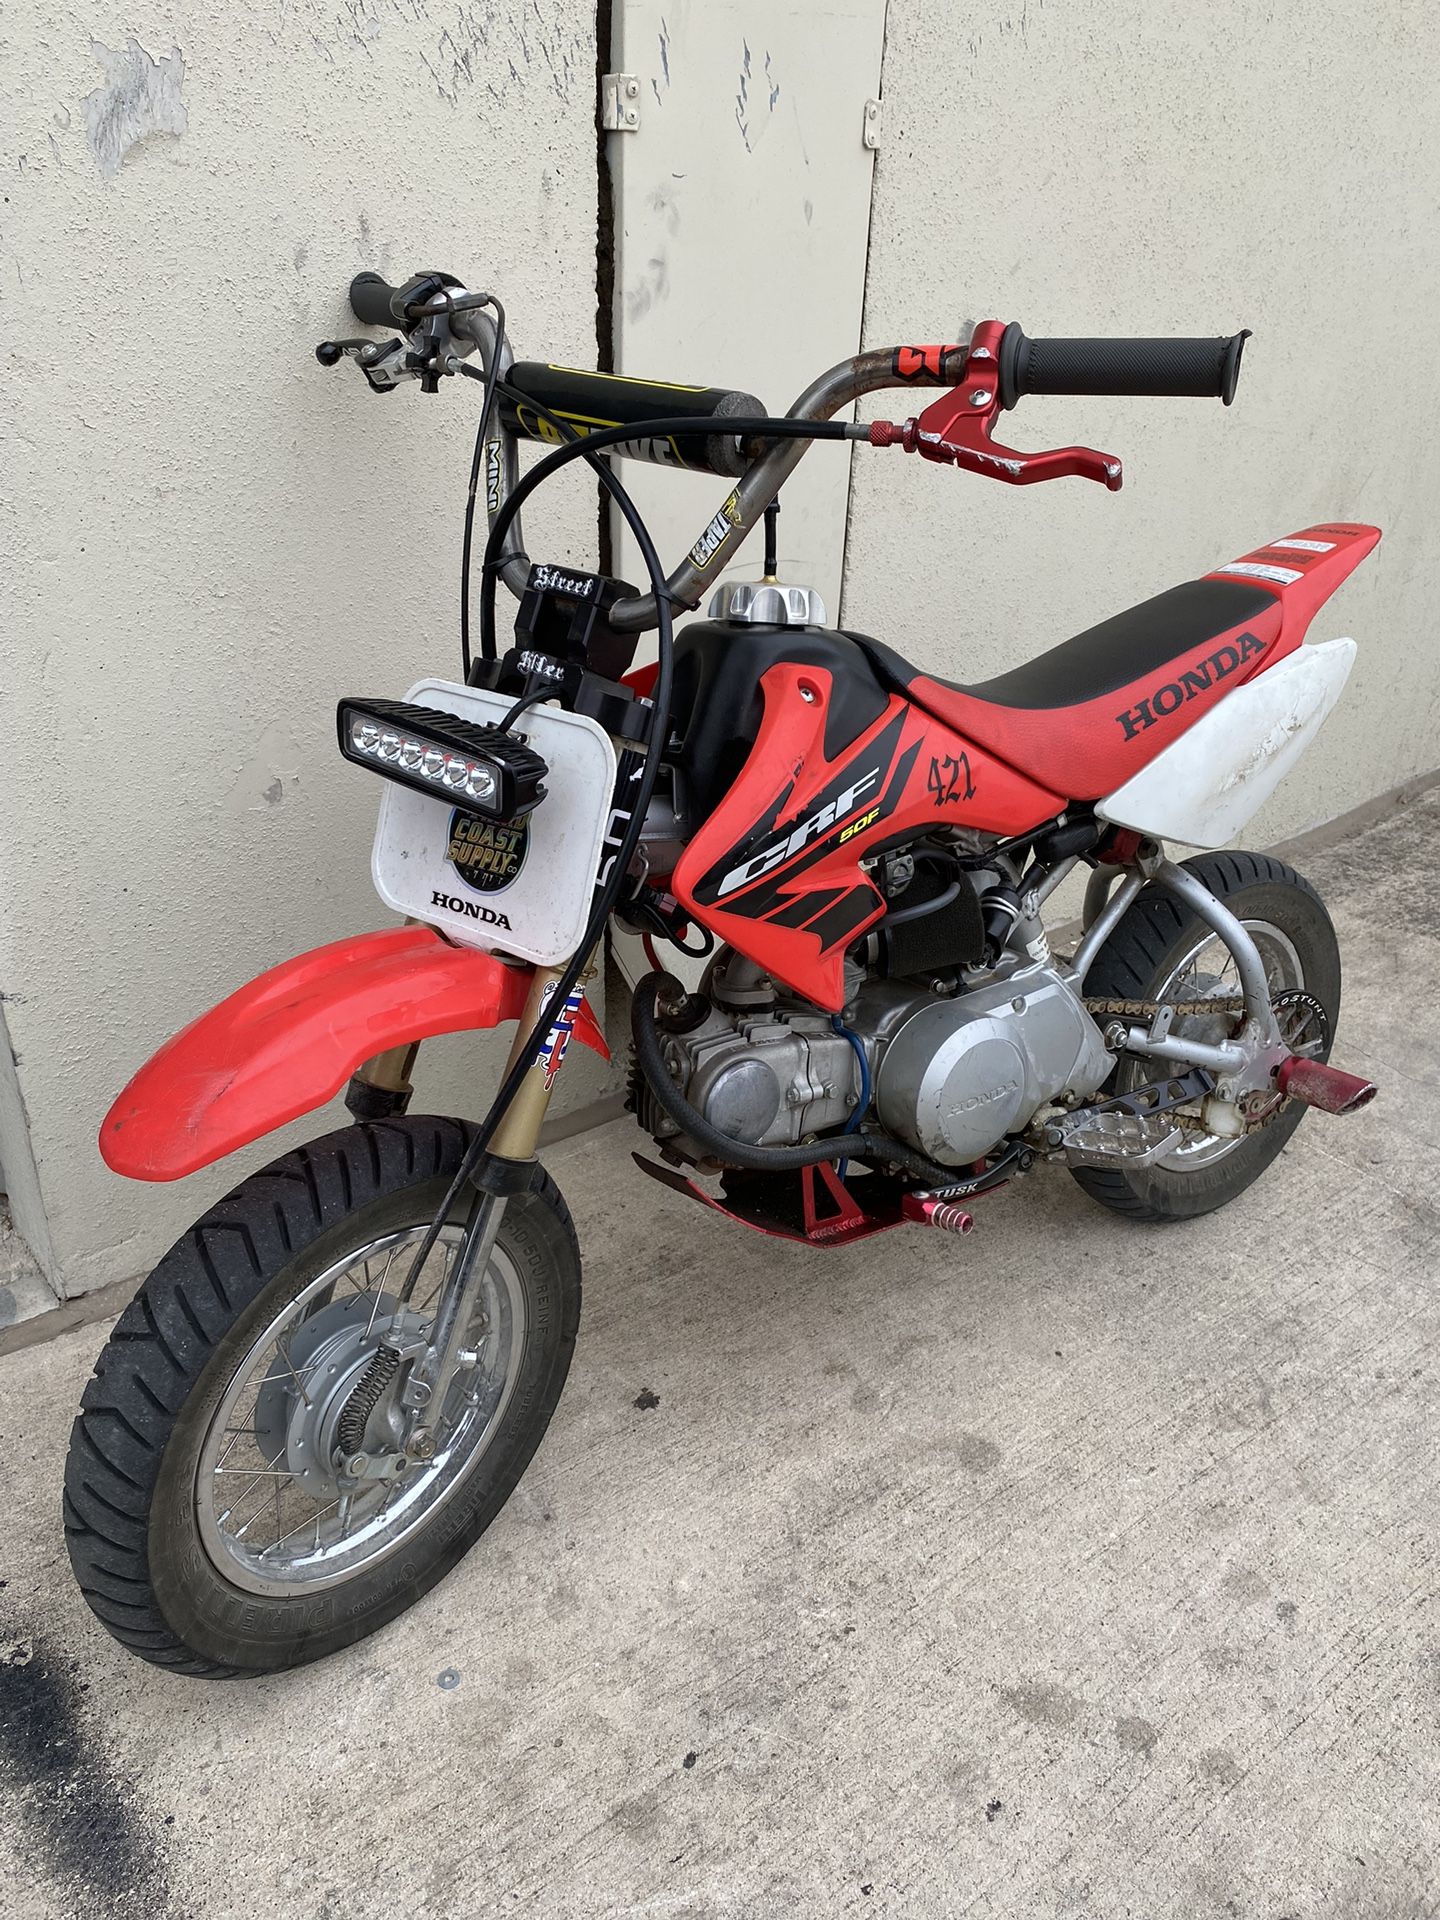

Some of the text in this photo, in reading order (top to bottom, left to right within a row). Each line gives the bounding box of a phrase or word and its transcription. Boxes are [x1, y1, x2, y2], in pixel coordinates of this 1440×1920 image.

[487, 441, 501, 512] MINI
[533, 566, 594, 597] Street
[1116, 631, 1267, 742] HONDA
[927, 751, 977, 807] 421
[454, 818, 523, 853] COAST
[717, 767, 880, 896] CRF
[839, 807, 881, 843] 50F
[448, 839, 518, 875] SUPPLY
[431, 891, 512, 931] HONDA
[946, 1079, 1020, 1119] HONDA
[935, 1182, 979, 1199] TUSK
[196, 1575, 335, 1632] PIRELLI
